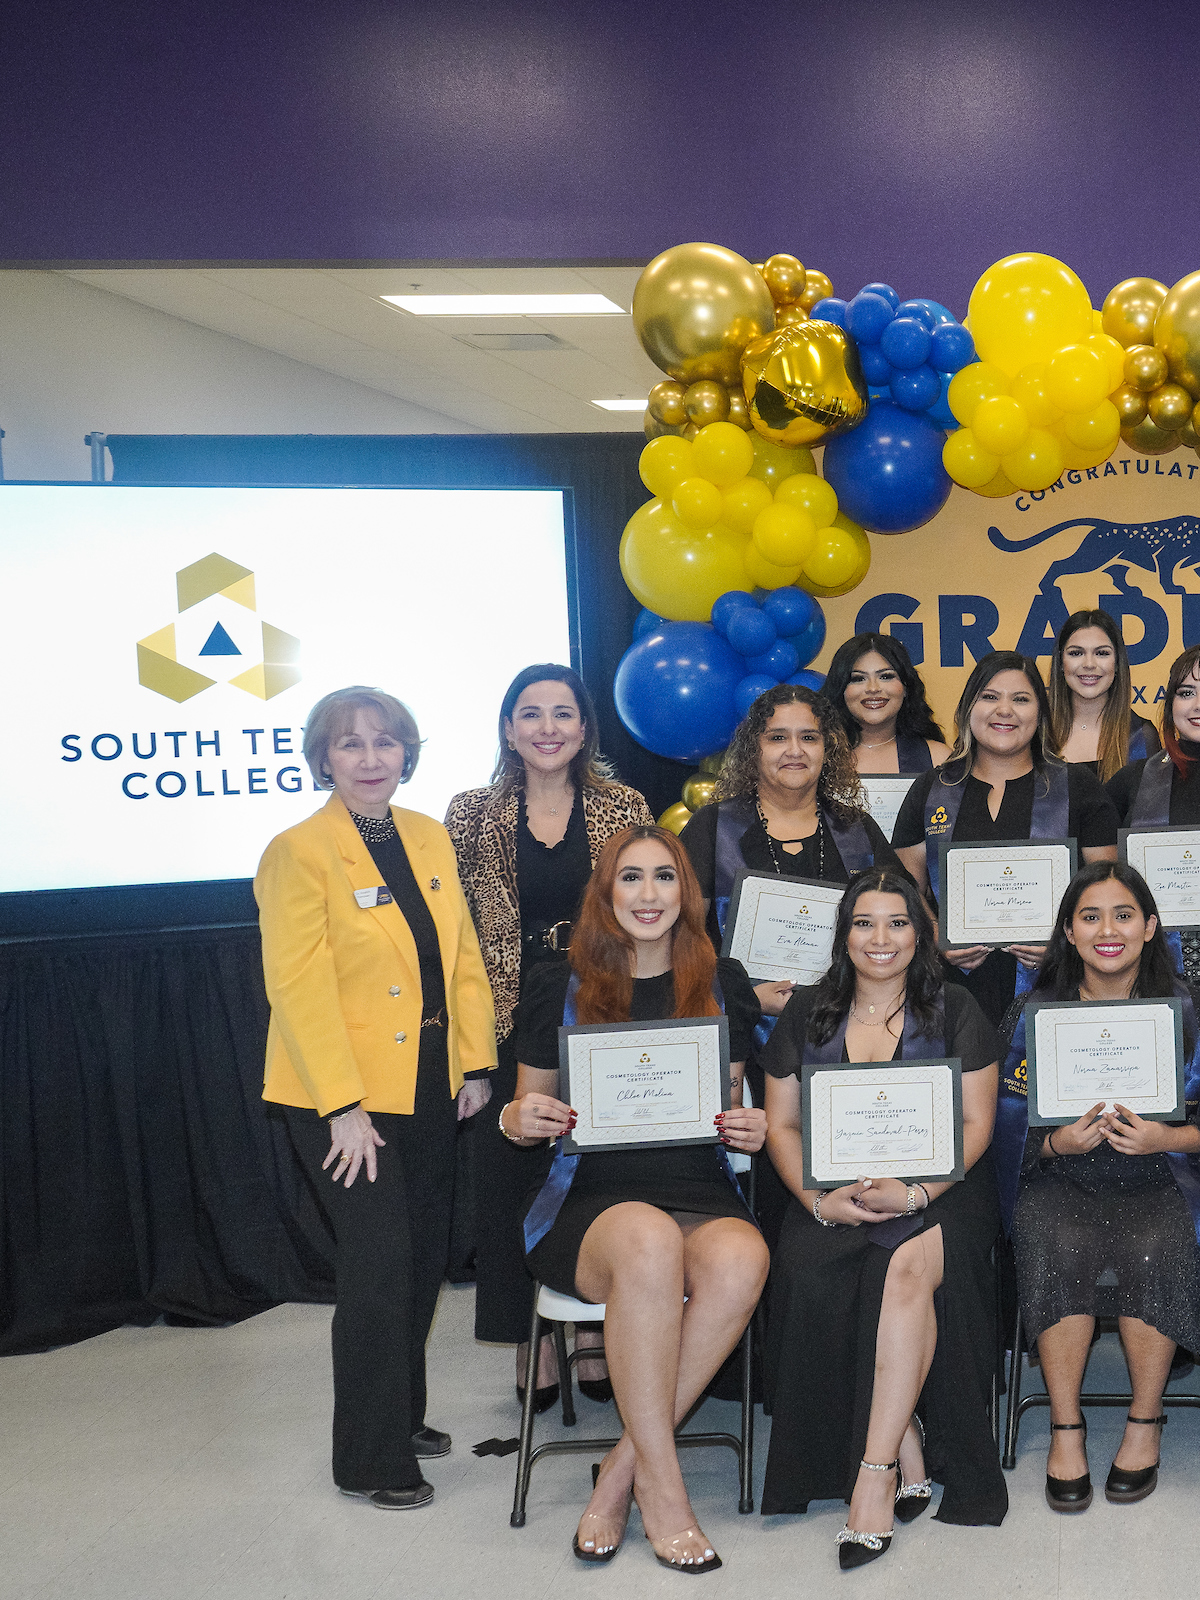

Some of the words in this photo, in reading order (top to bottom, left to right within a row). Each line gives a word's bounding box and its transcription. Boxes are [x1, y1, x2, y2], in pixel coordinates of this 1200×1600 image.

[61, 730, 221, 762] SOUTH
[776, 935, 792, 944] Eva
[616, 1090, 640, 1102] Chloe
[643, 1088, 674, 1099] Molina
